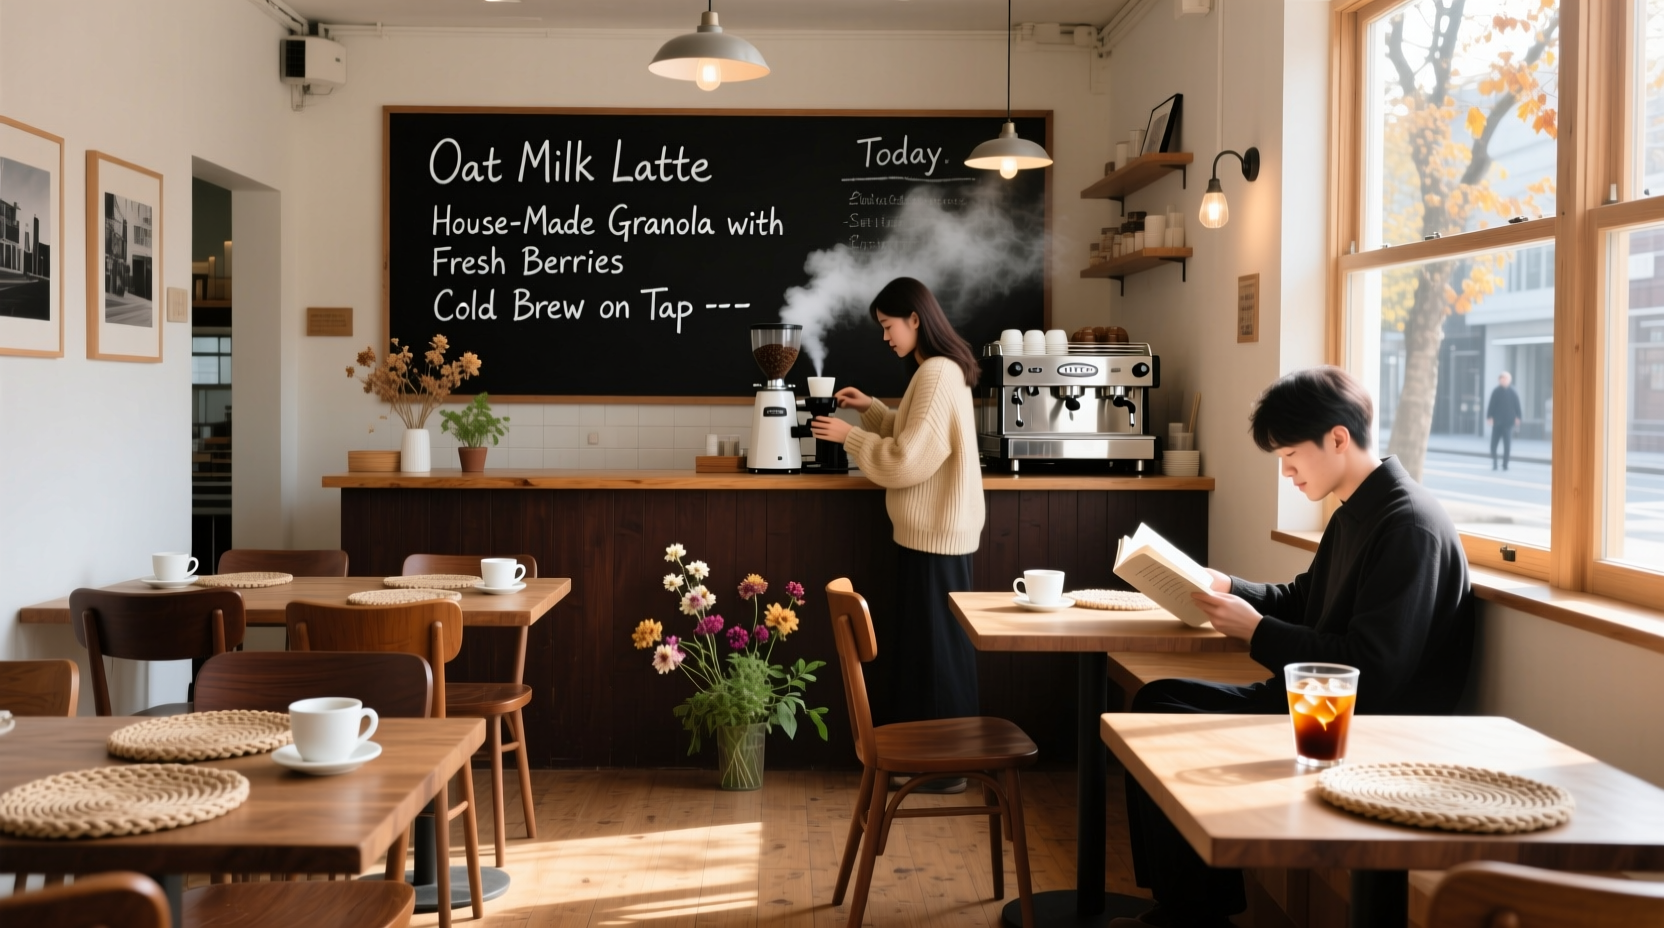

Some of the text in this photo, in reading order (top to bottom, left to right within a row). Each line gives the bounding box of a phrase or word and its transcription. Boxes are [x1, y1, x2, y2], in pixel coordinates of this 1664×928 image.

[429, 137, 713, 185] Oat Milk Latte
[432, 203, 785, 243] House-Made Granola with
[432, 245, 624, 277] Fresh Berries
[433, 288, 498, 322] Cold
[513, 287, 585, 322] Brew
[599, 300, 630, 320] on
[640, 286, 694, 335] Tap
